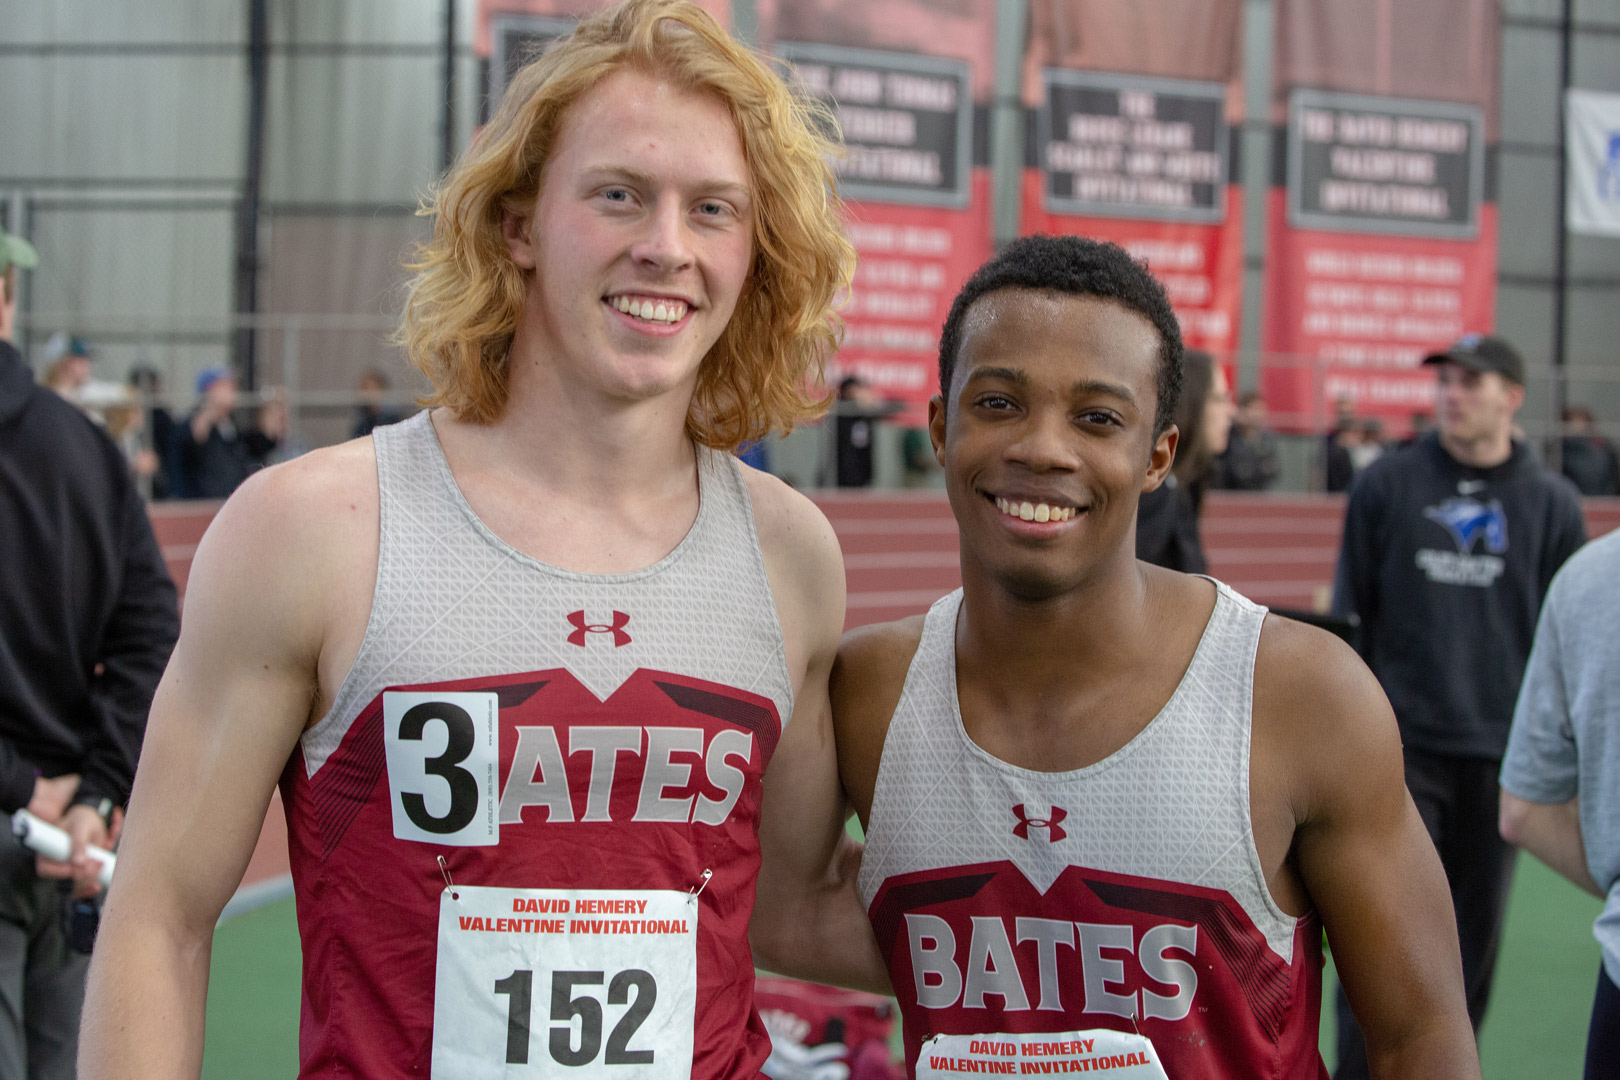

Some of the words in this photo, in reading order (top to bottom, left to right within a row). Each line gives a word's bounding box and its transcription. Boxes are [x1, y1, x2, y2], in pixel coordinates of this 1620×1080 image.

[398, 702, 478, 834] 3
[498, 726, 753, 826] ATES
[459, 916, 565, 934] VALENTINE
[570, 919, 689, 934] INVITATIONAL
[512, 898, 570, 914] DAVID
[575, 899, 648, 914] HEMERY
[903, 913, 1198, 1021] BATES
[494, 968, 657, 1067] 152
[969, 1040, 1017, 1057] DAVID
[1021, 1039, 1095, 1057] HEMERY
[930, 1056, 1017, 1074] VALENTINE
[1020, 1051, 1151, 1075] INVITATIONAL
